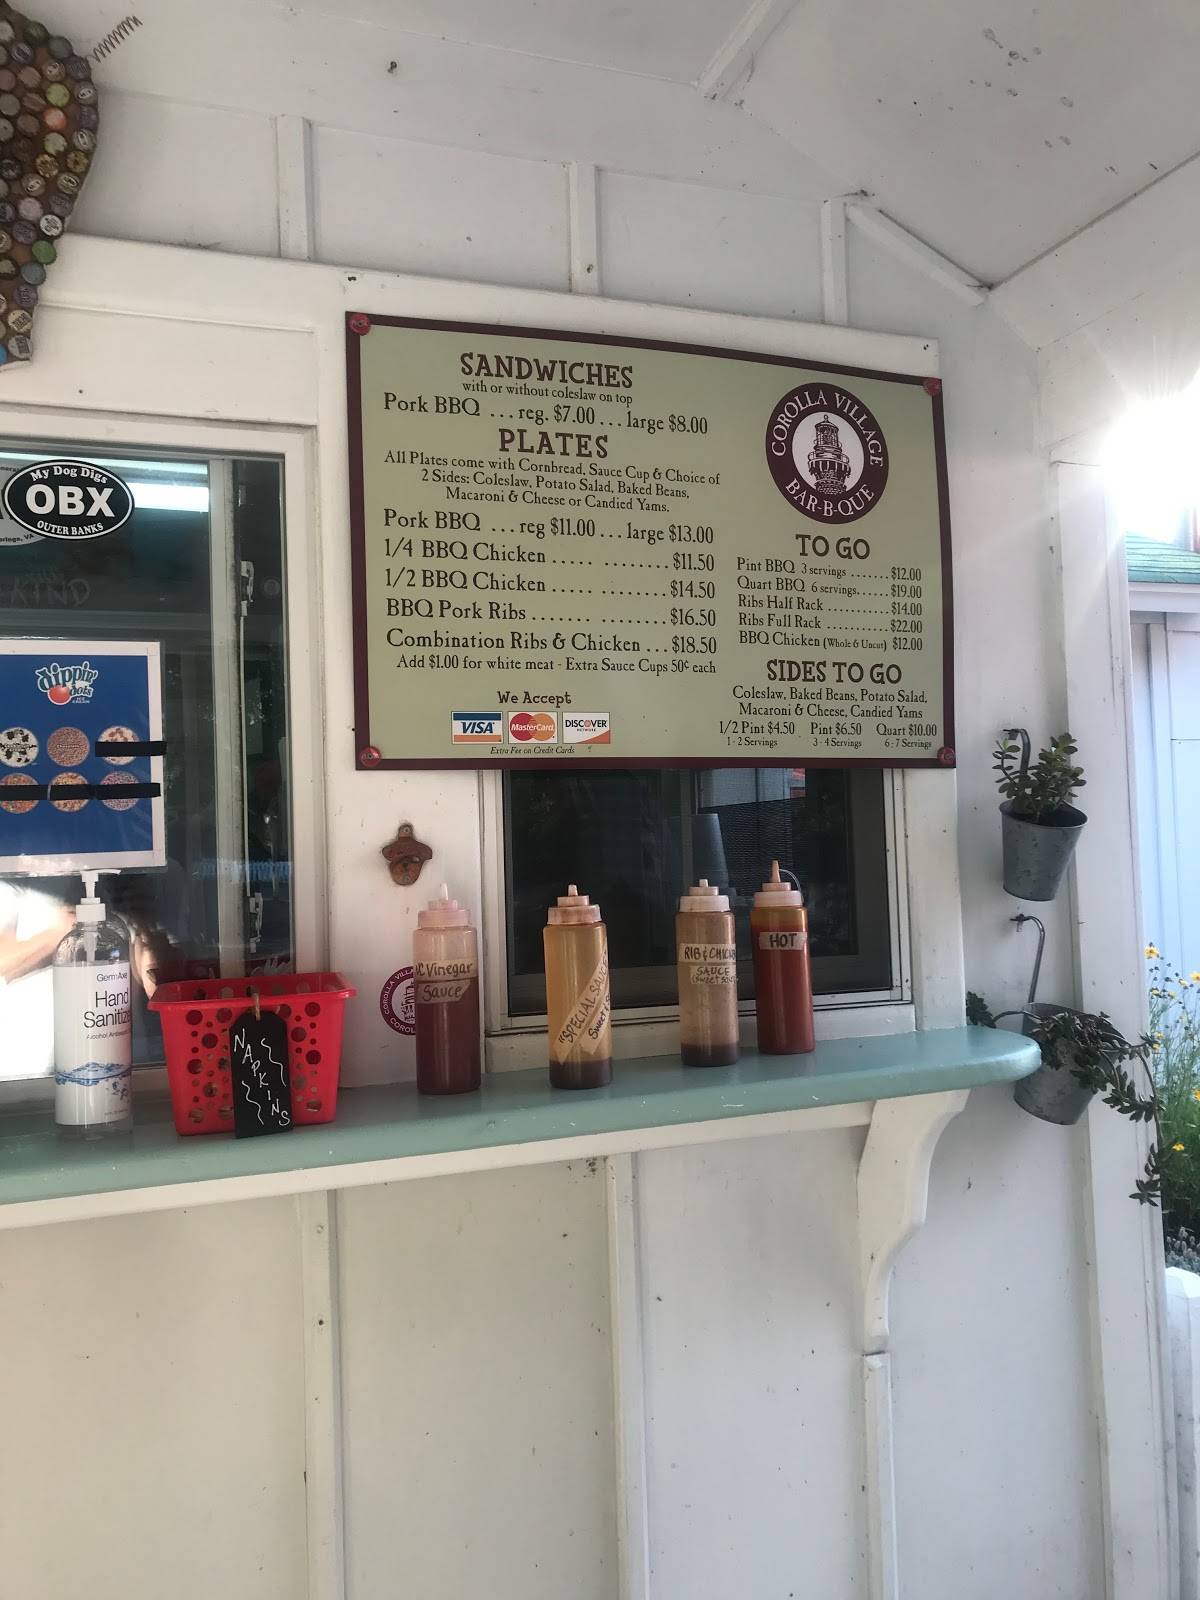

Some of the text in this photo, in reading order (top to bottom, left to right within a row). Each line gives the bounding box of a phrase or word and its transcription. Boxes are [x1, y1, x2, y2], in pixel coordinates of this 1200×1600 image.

[460, 351, 633, 388] SANDWICHES
[461, 379, 633, 407] with or without coleslaw on top
[384, 392, 708, 435] Pork BBQ reg. $7.00 large $8.00
[770, 389, 883, 467] COROLLA VILLAGE
[498, 430, 608, 459] PLATES
[30, 469, 49, 482] My
[53, 466, 78, 478] Dog
[81, 466, 108, 484] Digs
[384, 450, 720, 485] All Plates come with Cornbread, Sauce Cup & Choice of
[421, 468, 689, 500] 2 Sides: Coleslaw, Potato Salad, Baked Beans,
[26, 484, 115, 518] OBX
[444, 484, 670, 512] Macaroni & Cheese or Candied Yams.
[786, 477, 875, 517] BAR-B-QUE
[37, 520, 104, 535] OUTER BANKS
[384, 508, 713, 545] Pork BBQ reg $11.00 large $13.00
[384, 537, 714, 573] 1/4 BBQ Chicken $11.50
[795, 534, 871, 560] TO GO
[736, 557, 921, 583] Pint BBQ 3 servings $12.00
[385, 566, 715, 599] 1/2 BBQ Chicken $14.50
[737, 575, 773, 592] Quart
[775, 576, 806, 595] BBQ
[811, 581, 818, 593] 6
[891, 584, 922, 599] $19.00
[385, 598, 717, 628] BBQ Pork Ribs $16.50
[738, 594, 922, 617] Ribs Half Rack $14.00
[738, 610, 923, 636] Ribs Full Rack $22.00
[387, 628, 717, 656] Combination Ribs & Chicken $18.50
[738, 628, 771, 647] BBQ
[772, 630, 821, 648] Chicken
[823, 637, 852, 650] (Whole
[852, 639, 860, 648] &
[892, 635, 923, 651] $12.00
[396, 653, 425, 671] Add
[429, 653, 461, 671] $1.00
[461, 655, 483, 669] for
[484, 655, 522, 670] white
[524, 659, 554, 672] meat
[565, 657, 598, 671] Extra
[599, 657, 637, 671] Sauce
[637, 658, 668, 677] Cups
[692, 660, 717, 673] each
[766, 657, 902, 686] SIDES TO GO
[497, 691, 572, 708] We Accept
[732, 685, 927, 705] Coleslaw, Baked Beans, Potato Salad,
[738, 700, 923, 720] Macaroni & Cheese, Candied Yams
[461, 721, 495, 734] VISA
[511, 723, 554, 732] MasterCard
[565, 719, 607, 728] DISCOVER
[720, 719, 795, 737] 1/2 Pint $4.50
[810, 720, 862, 738] Pint $6.50
[876, 722, 938, 739] Quart $10.00
[490, 747, 509, 755] Extra
[533, 746, 554, 754] Credit
[744, 736, 778, 749] Servings
[829, 736, 863, 750] Servings
[901, 737, 932, 750] Servings
[769, 934, 797, 948] HOT
[684, 947, 700, 960] RIB
[426, 962, 473, 977] Vinegar
[696, 967, 730, 976] SAUCE
[95, 988, 129, 1008] Hand
[383, 981, 395, 1015] COROLLA
[422, 985, 462, 1002] Sauce
[234, 1028, 291, 1127] NAPKINS
